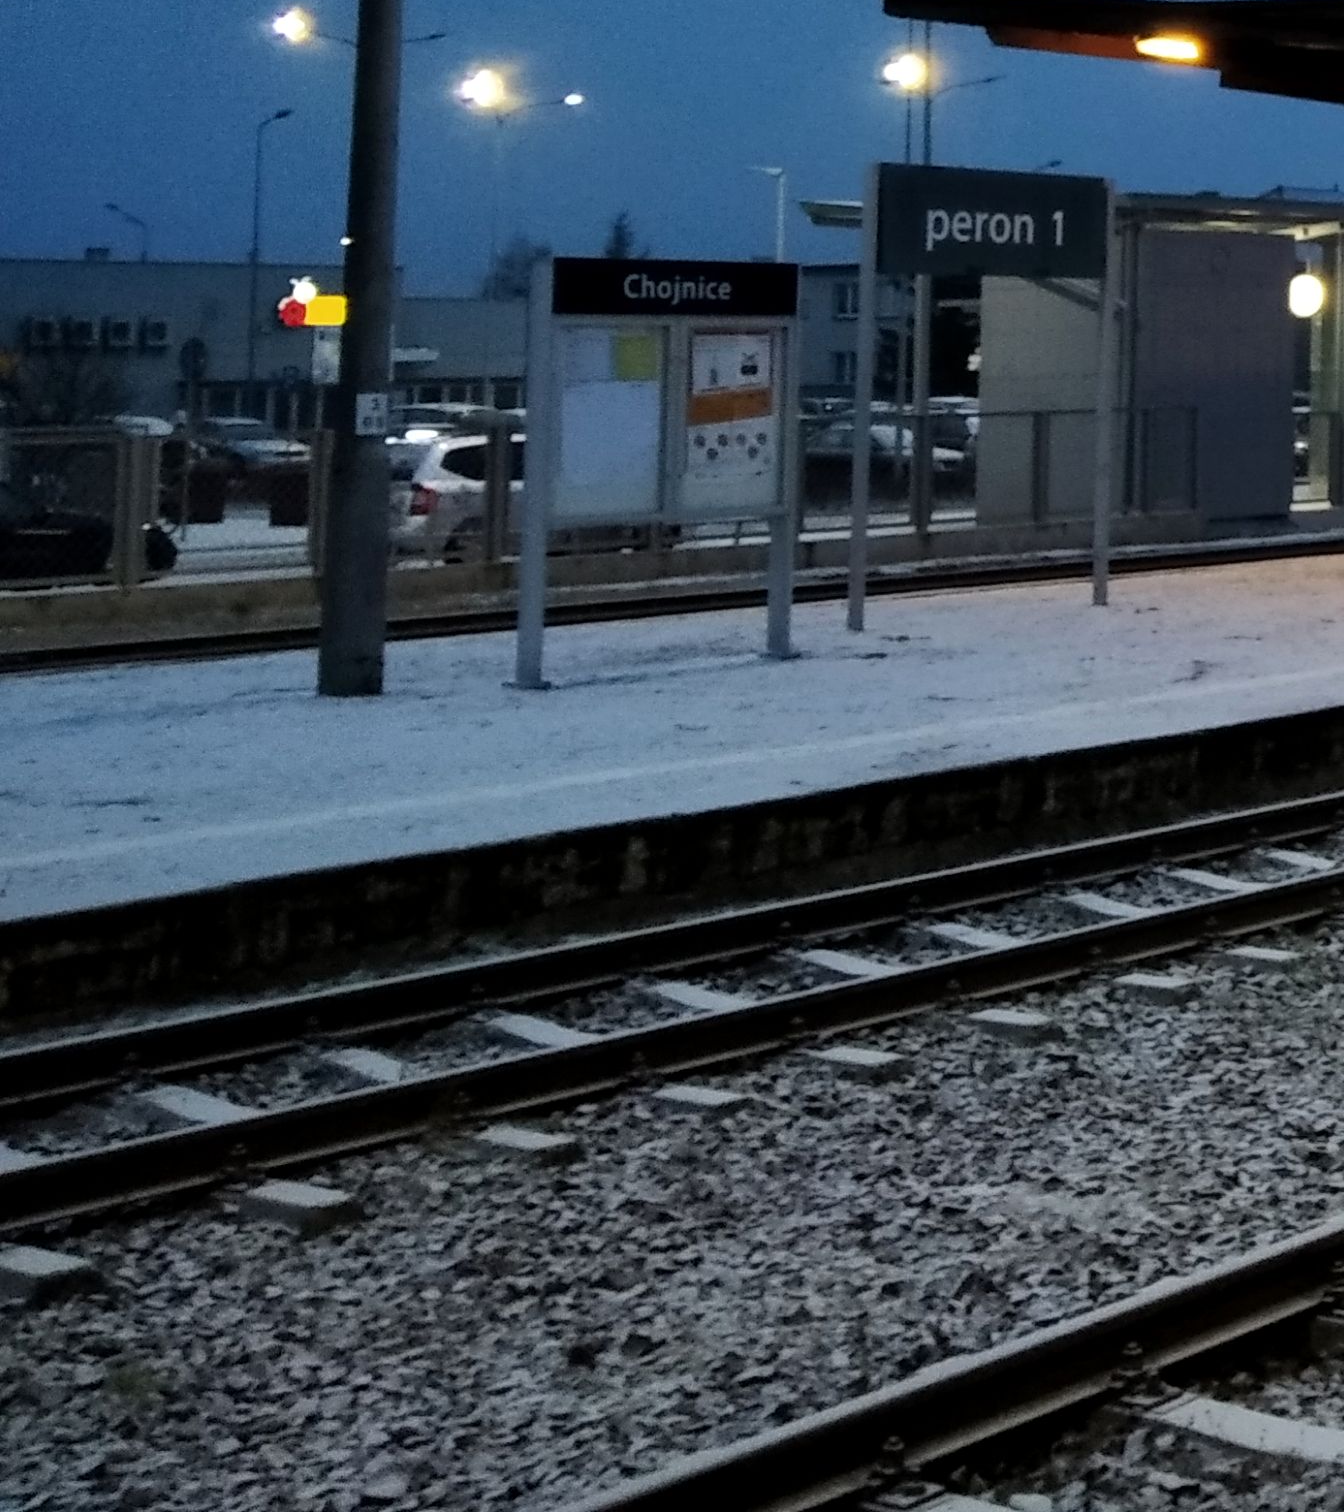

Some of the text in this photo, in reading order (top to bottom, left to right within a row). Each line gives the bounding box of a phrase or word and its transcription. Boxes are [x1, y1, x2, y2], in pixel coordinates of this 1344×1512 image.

[925, 208, 1065, 251] peron 1
[623, 273, 733, 305] Chojnice
